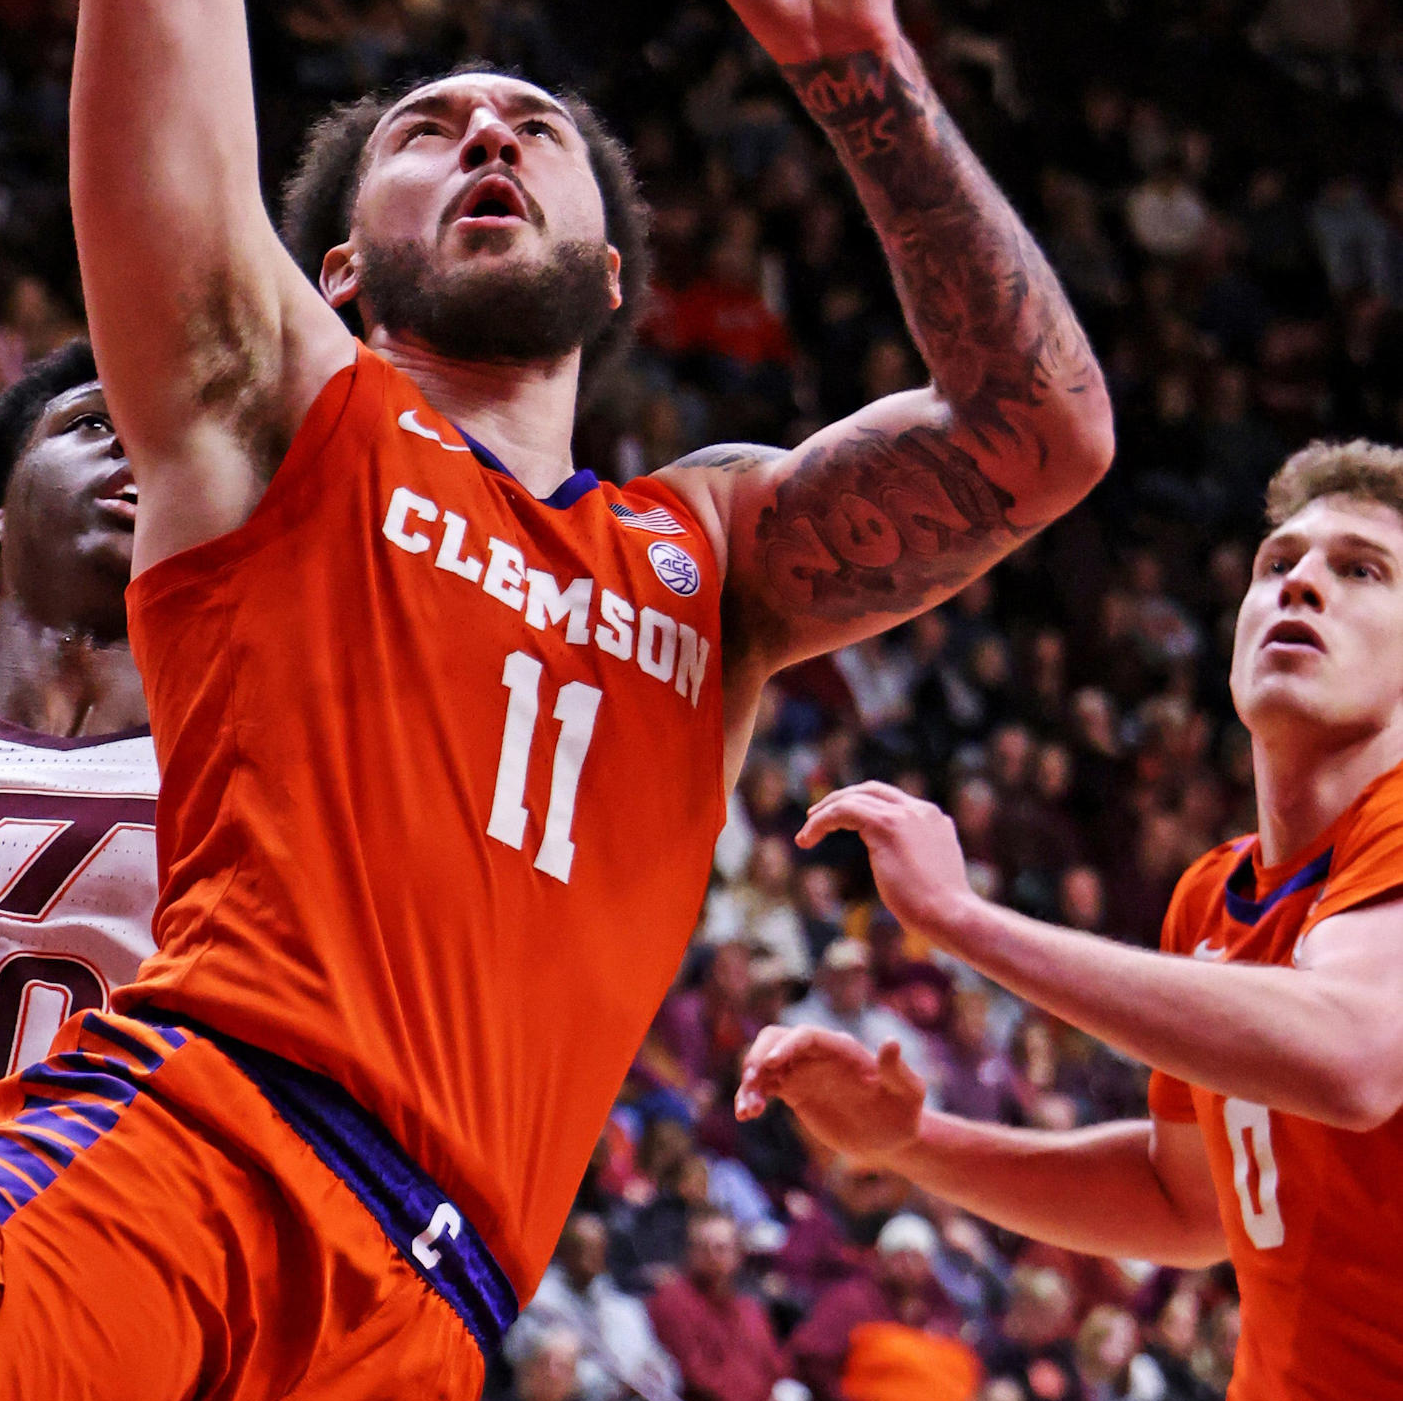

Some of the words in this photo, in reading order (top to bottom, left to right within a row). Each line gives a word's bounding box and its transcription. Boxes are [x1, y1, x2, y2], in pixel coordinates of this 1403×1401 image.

[382, 487, 710, 709] CLEMSON
[659, 558, 693, 575] ACC
[486, 650, 603, 884] 11
[1223, 1097, 1285, 1250] 0
